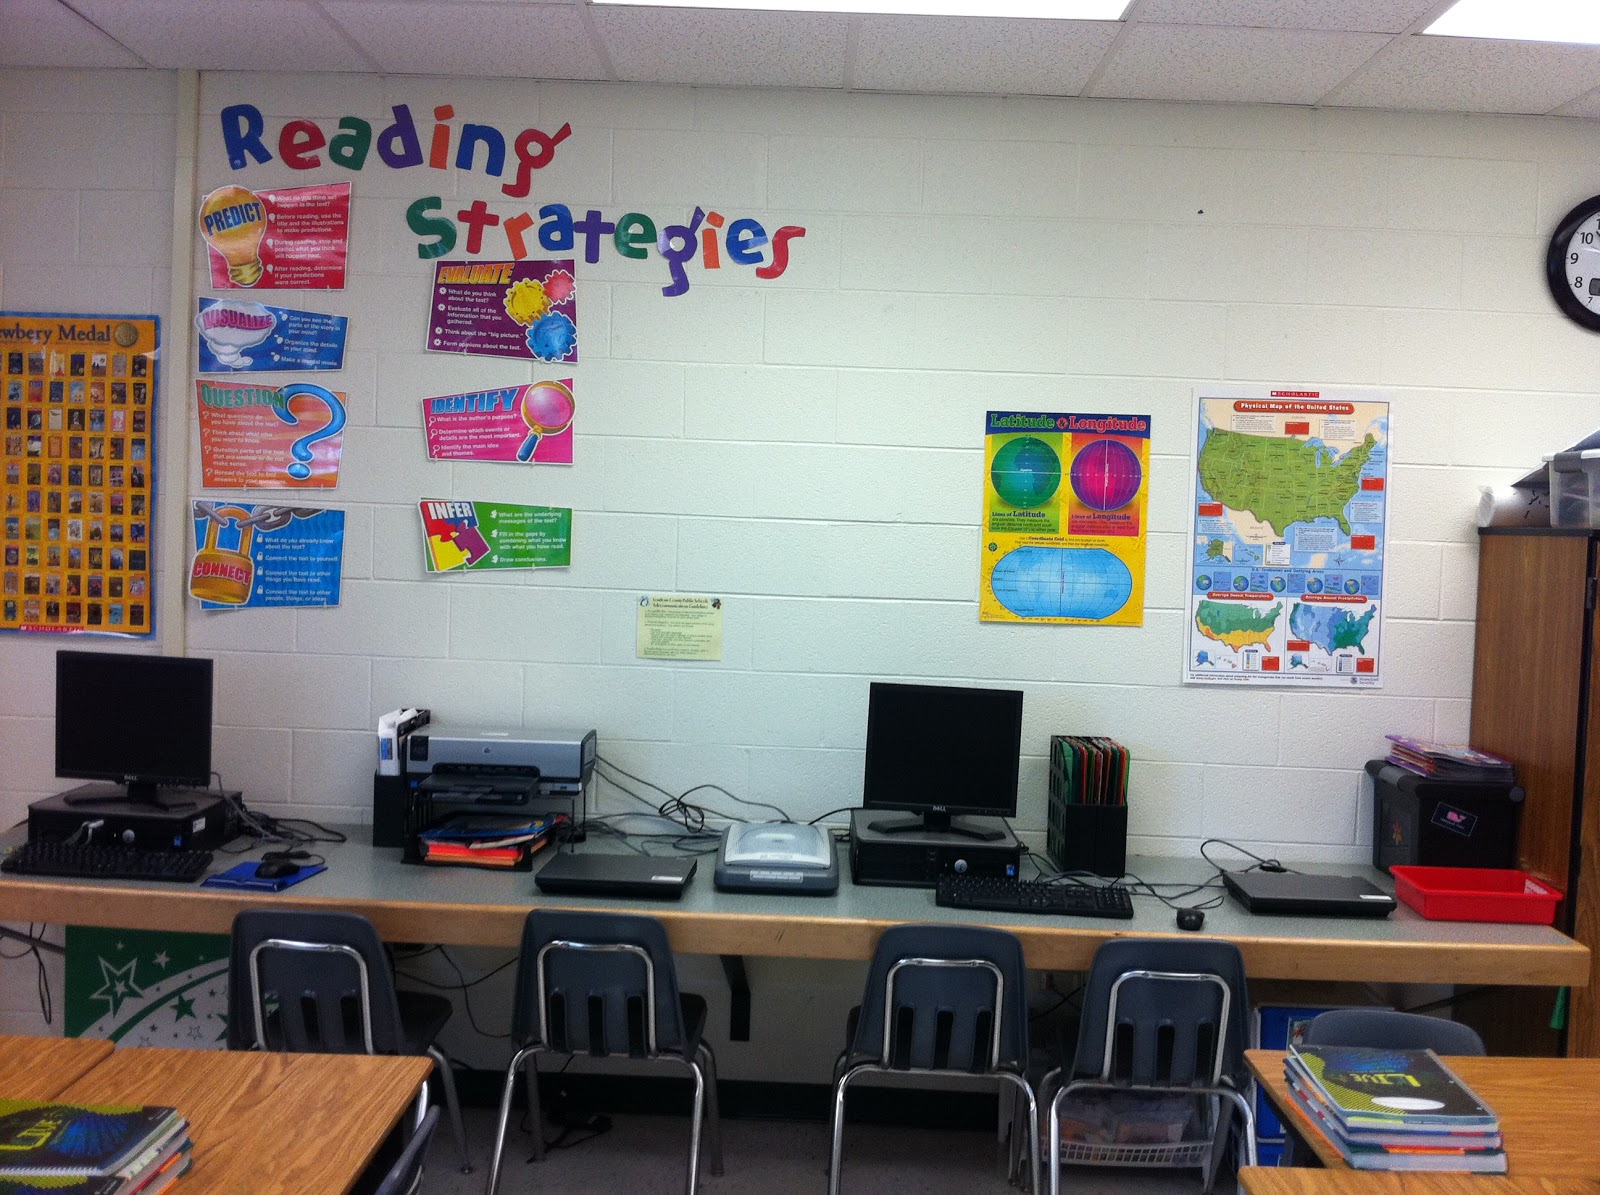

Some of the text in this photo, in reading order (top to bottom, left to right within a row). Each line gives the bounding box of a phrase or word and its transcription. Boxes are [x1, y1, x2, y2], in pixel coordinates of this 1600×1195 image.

[220, 103, 572, 198] Reading
[204, 202, 262, 236] PREDICT
[406, 196, 806, 296] Strategies
[1580, 232, 1593, 244] 10
[1570, 252, 1578, 264] 9
[438, 263, 515, 284] EVALUATE
[1574, 276, 1582, 288] 8
[202, 308, 273, 330] VISUALIZE
[0, 322, 111, 345] wbery Medal
[202, 384, 286, 410] QUESTION
[432, 387, 519, 414] IDENTIFY
[991, 414, 1054, 428] Latitude
[1069, 416, 1147, 432] Longitude
[428, 502, 472, 520] INFER
[192, 562, 251, 584] CONNECT
